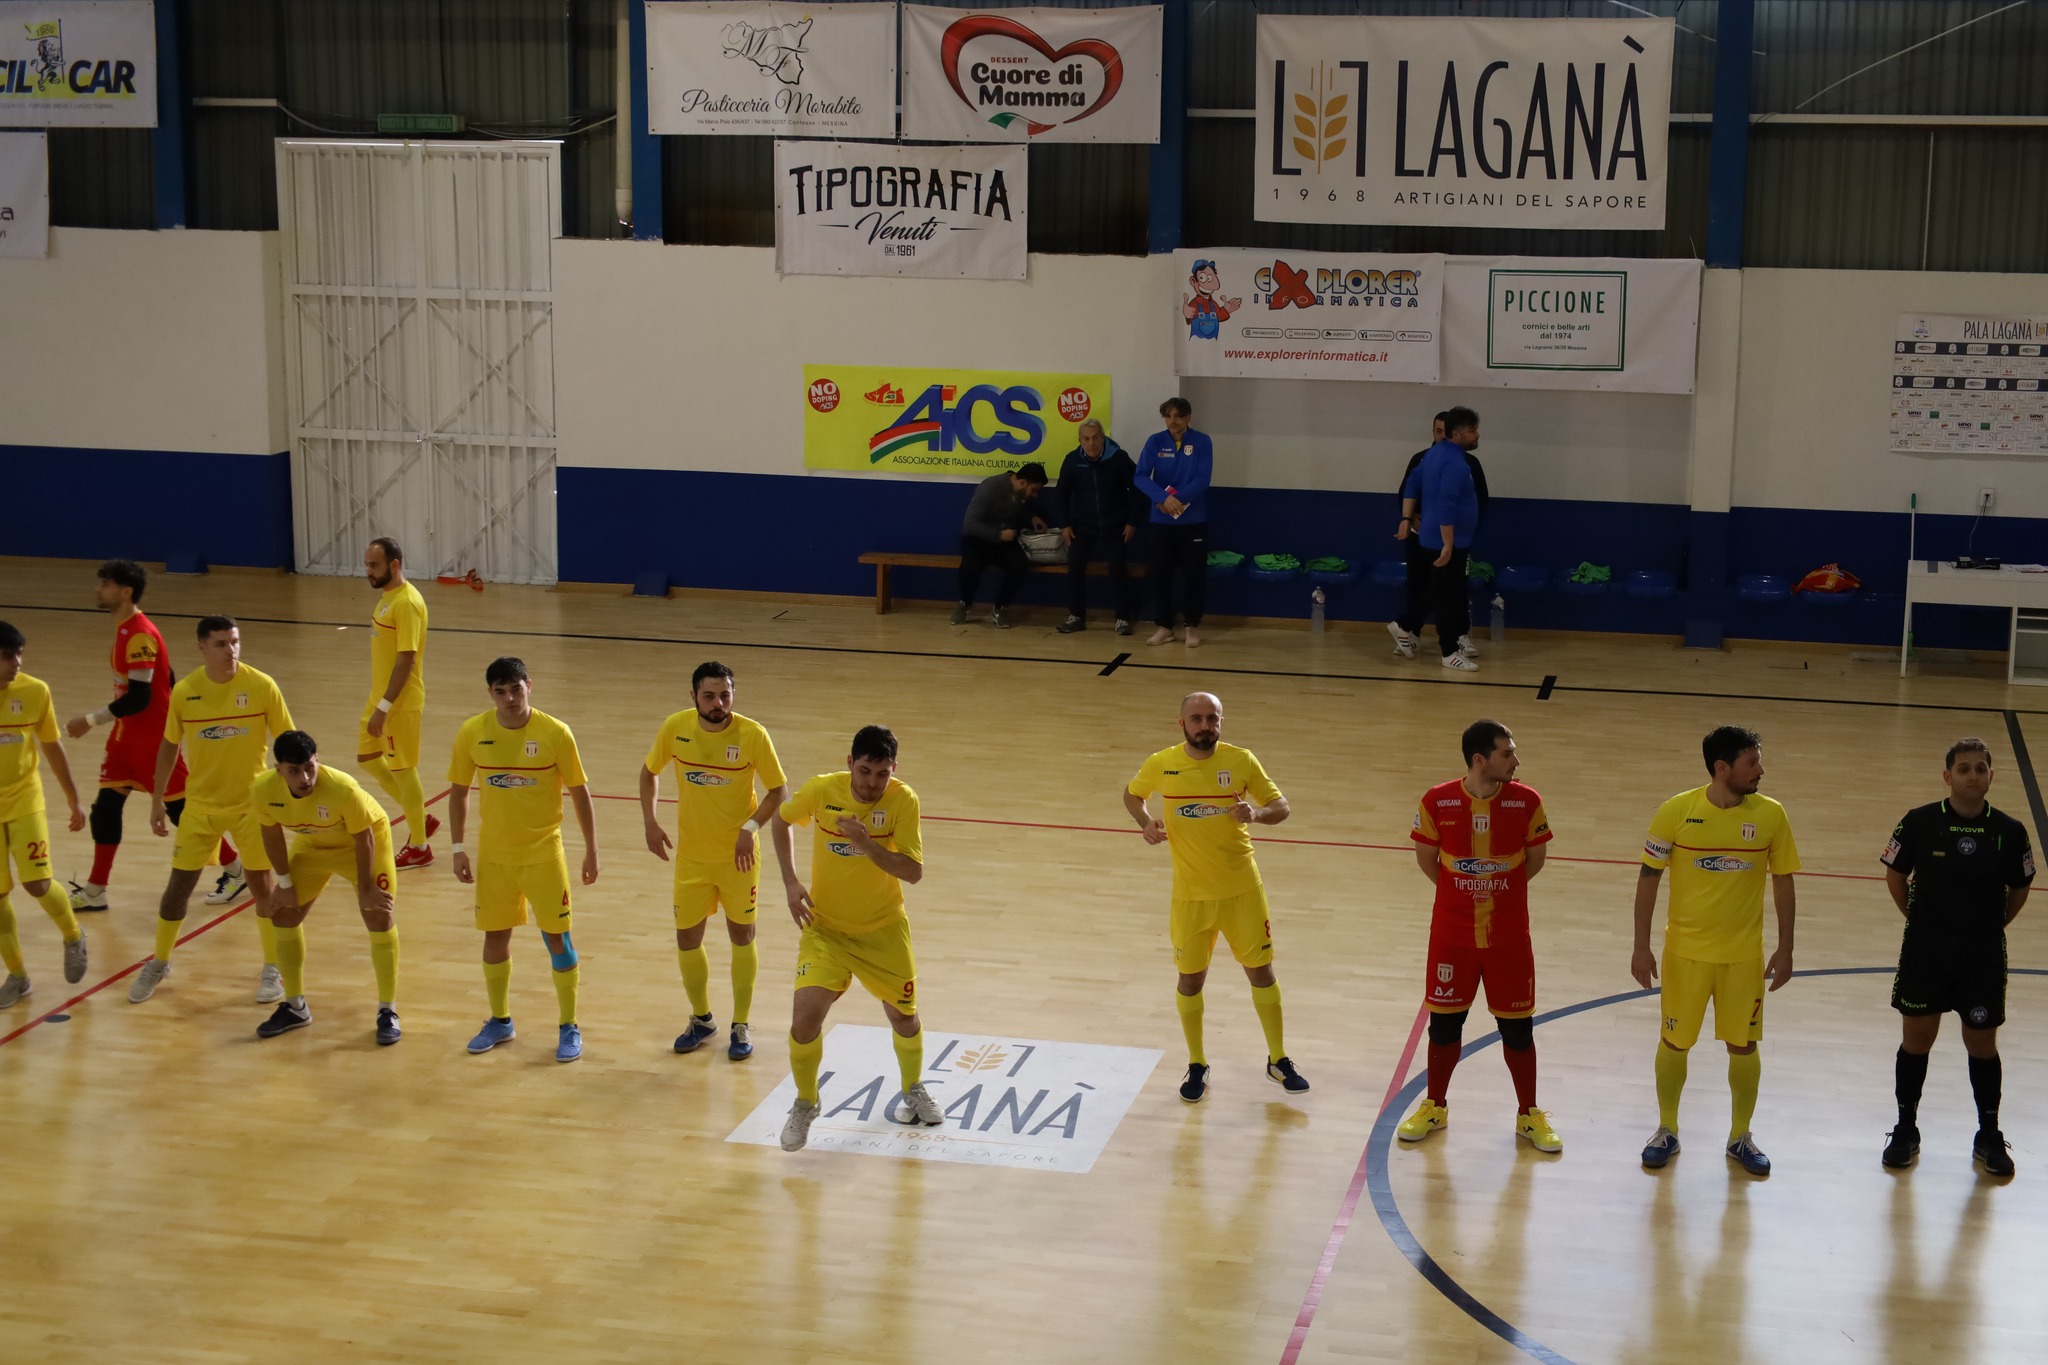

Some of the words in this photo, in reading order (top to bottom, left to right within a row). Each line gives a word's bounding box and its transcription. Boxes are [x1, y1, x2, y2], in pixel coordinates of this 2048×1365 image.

[68, 59, 136, 93] CAR
[970, 63, 1051, 85] Cuore
[1058, 64, 1083, 85] di
[681, 88, 771, 113] Pasticceria
[774, 88, 863, 116] Morabito
[979, 85, 1086, 106] Mamma
[1394, 34, 1648, 181] LAGANÀ
[789, 165, 1012, 222] TIPOGRAFIA
[1272, 188, 1366, 202] 1968
[1394, 192, 1504, 207] ARTIGIANI
[1516, 194, 1553, 207] DEL
[1565, 194, 1648, 209] SAPORE
[855, 211, 947, 245] Venuti
[884, 245, 896, 255] DAL
[896, 245, 916, 256] 1961
[1254, 293, 1418, 308] INFORMATICA
[1504, 290, 1606, 314] PICCIONE
[1557, 323, 1576, 331] belle
[1963, 320, 1989, 339] PALA
[1991, 317, 2032, 340] LAGANÀ
[1224, 349, 1388, 362] www.explorerinformatica.it
[810, 382, 836, 396] NO
[812, 395, 838, 404] DOPING
[1060, 391, 1087, 406] NO
[1062, 404, 1088, 413] DOPING
[892, 456, 951, 465] ASSOCIAZIONE
[952, 458, 984, 467] ITALIANA
[985, 460, 1020, 469] CULTURA
[27, 840, 48, 861] 22
[377, 873, 389, 891] 6
[1454, 877, 1509, 891] TIPOGRAFIA
[562, 889, 569, 906] 4
[751, 885, 757, 904] 5
[903, 980, 915, 998] 9
[1528, 976, 1533, 996] 1
[1752, 998, 1762, 1019] 7
[895, 1131, 947, 1142] 1968
[908, 1144, 951, 1154] DEL
[967, 1149, 1061, 1164] SAPORE
